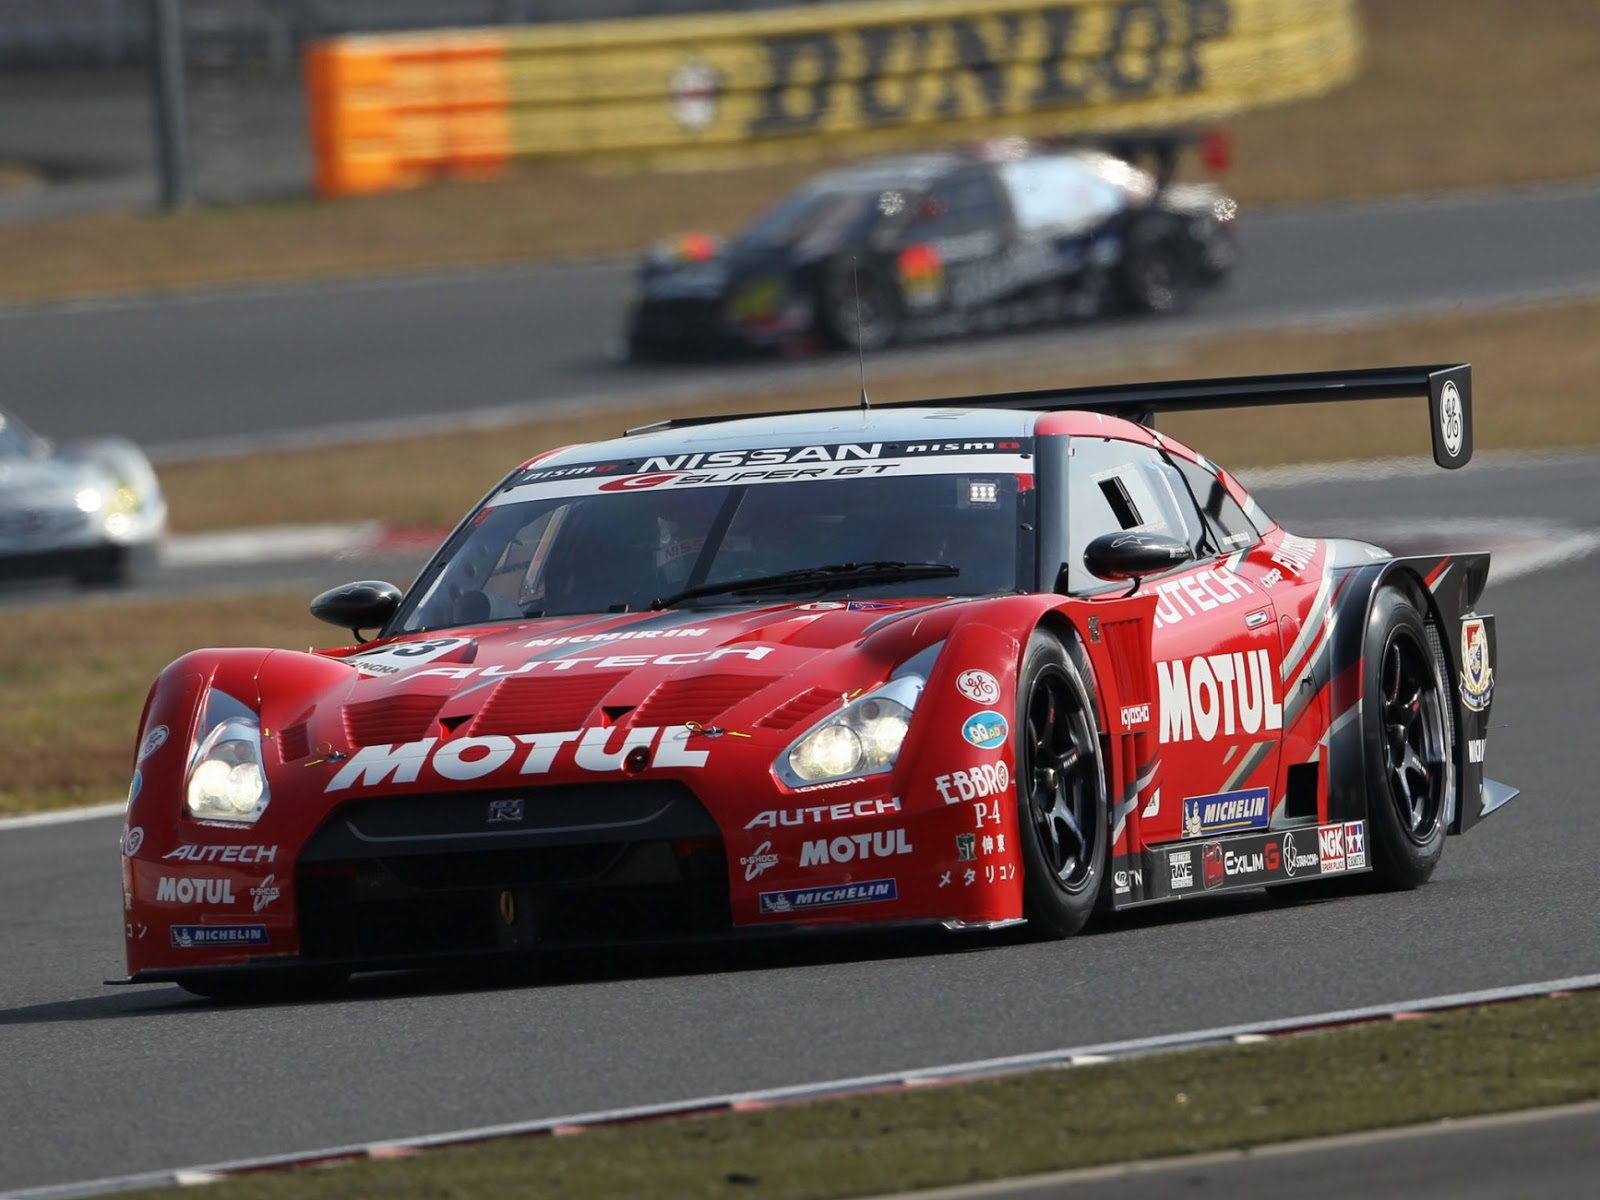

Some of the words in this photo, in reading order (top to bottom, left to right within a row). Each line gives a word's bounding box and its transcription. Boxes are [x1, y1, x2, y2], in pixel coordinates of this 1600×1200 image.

[636, 443, 883, 473] NISSAN
[905, 441, 1020, 453] nismo
[674, 467, 828, 486] SUPER
[833, 463, 900, 476] GT
[524, 628, 710, 648] NICHIRIN
[391, 645, 776, 685] AUTECH
[1156, 649, 1283, 744] MOTUL
[323, 725, 711, 793] MOTUL
[935, 760, 1009, 805] EBBRO
[743, 797, 902, 830] AUTECH
[973, 799, 1001, 828] P-4
[1203, 797, 1266, 824] MICHELIN
[161, 844, 279, 863] AUTECH
[799, 828, 913, 868] MOTUL
[1224, 850, 1265, 875] EXILIM
[1264, 842, 1280, 871] G
[1320, 829, 1344, 859] NGK
[938, 863, 1016, 888] メタリコン
[156, 877, 235, 904] MOTUL
[796, 883, 890, 905] MICHELIN
[194, 928, 262, 941] MICHELIN
